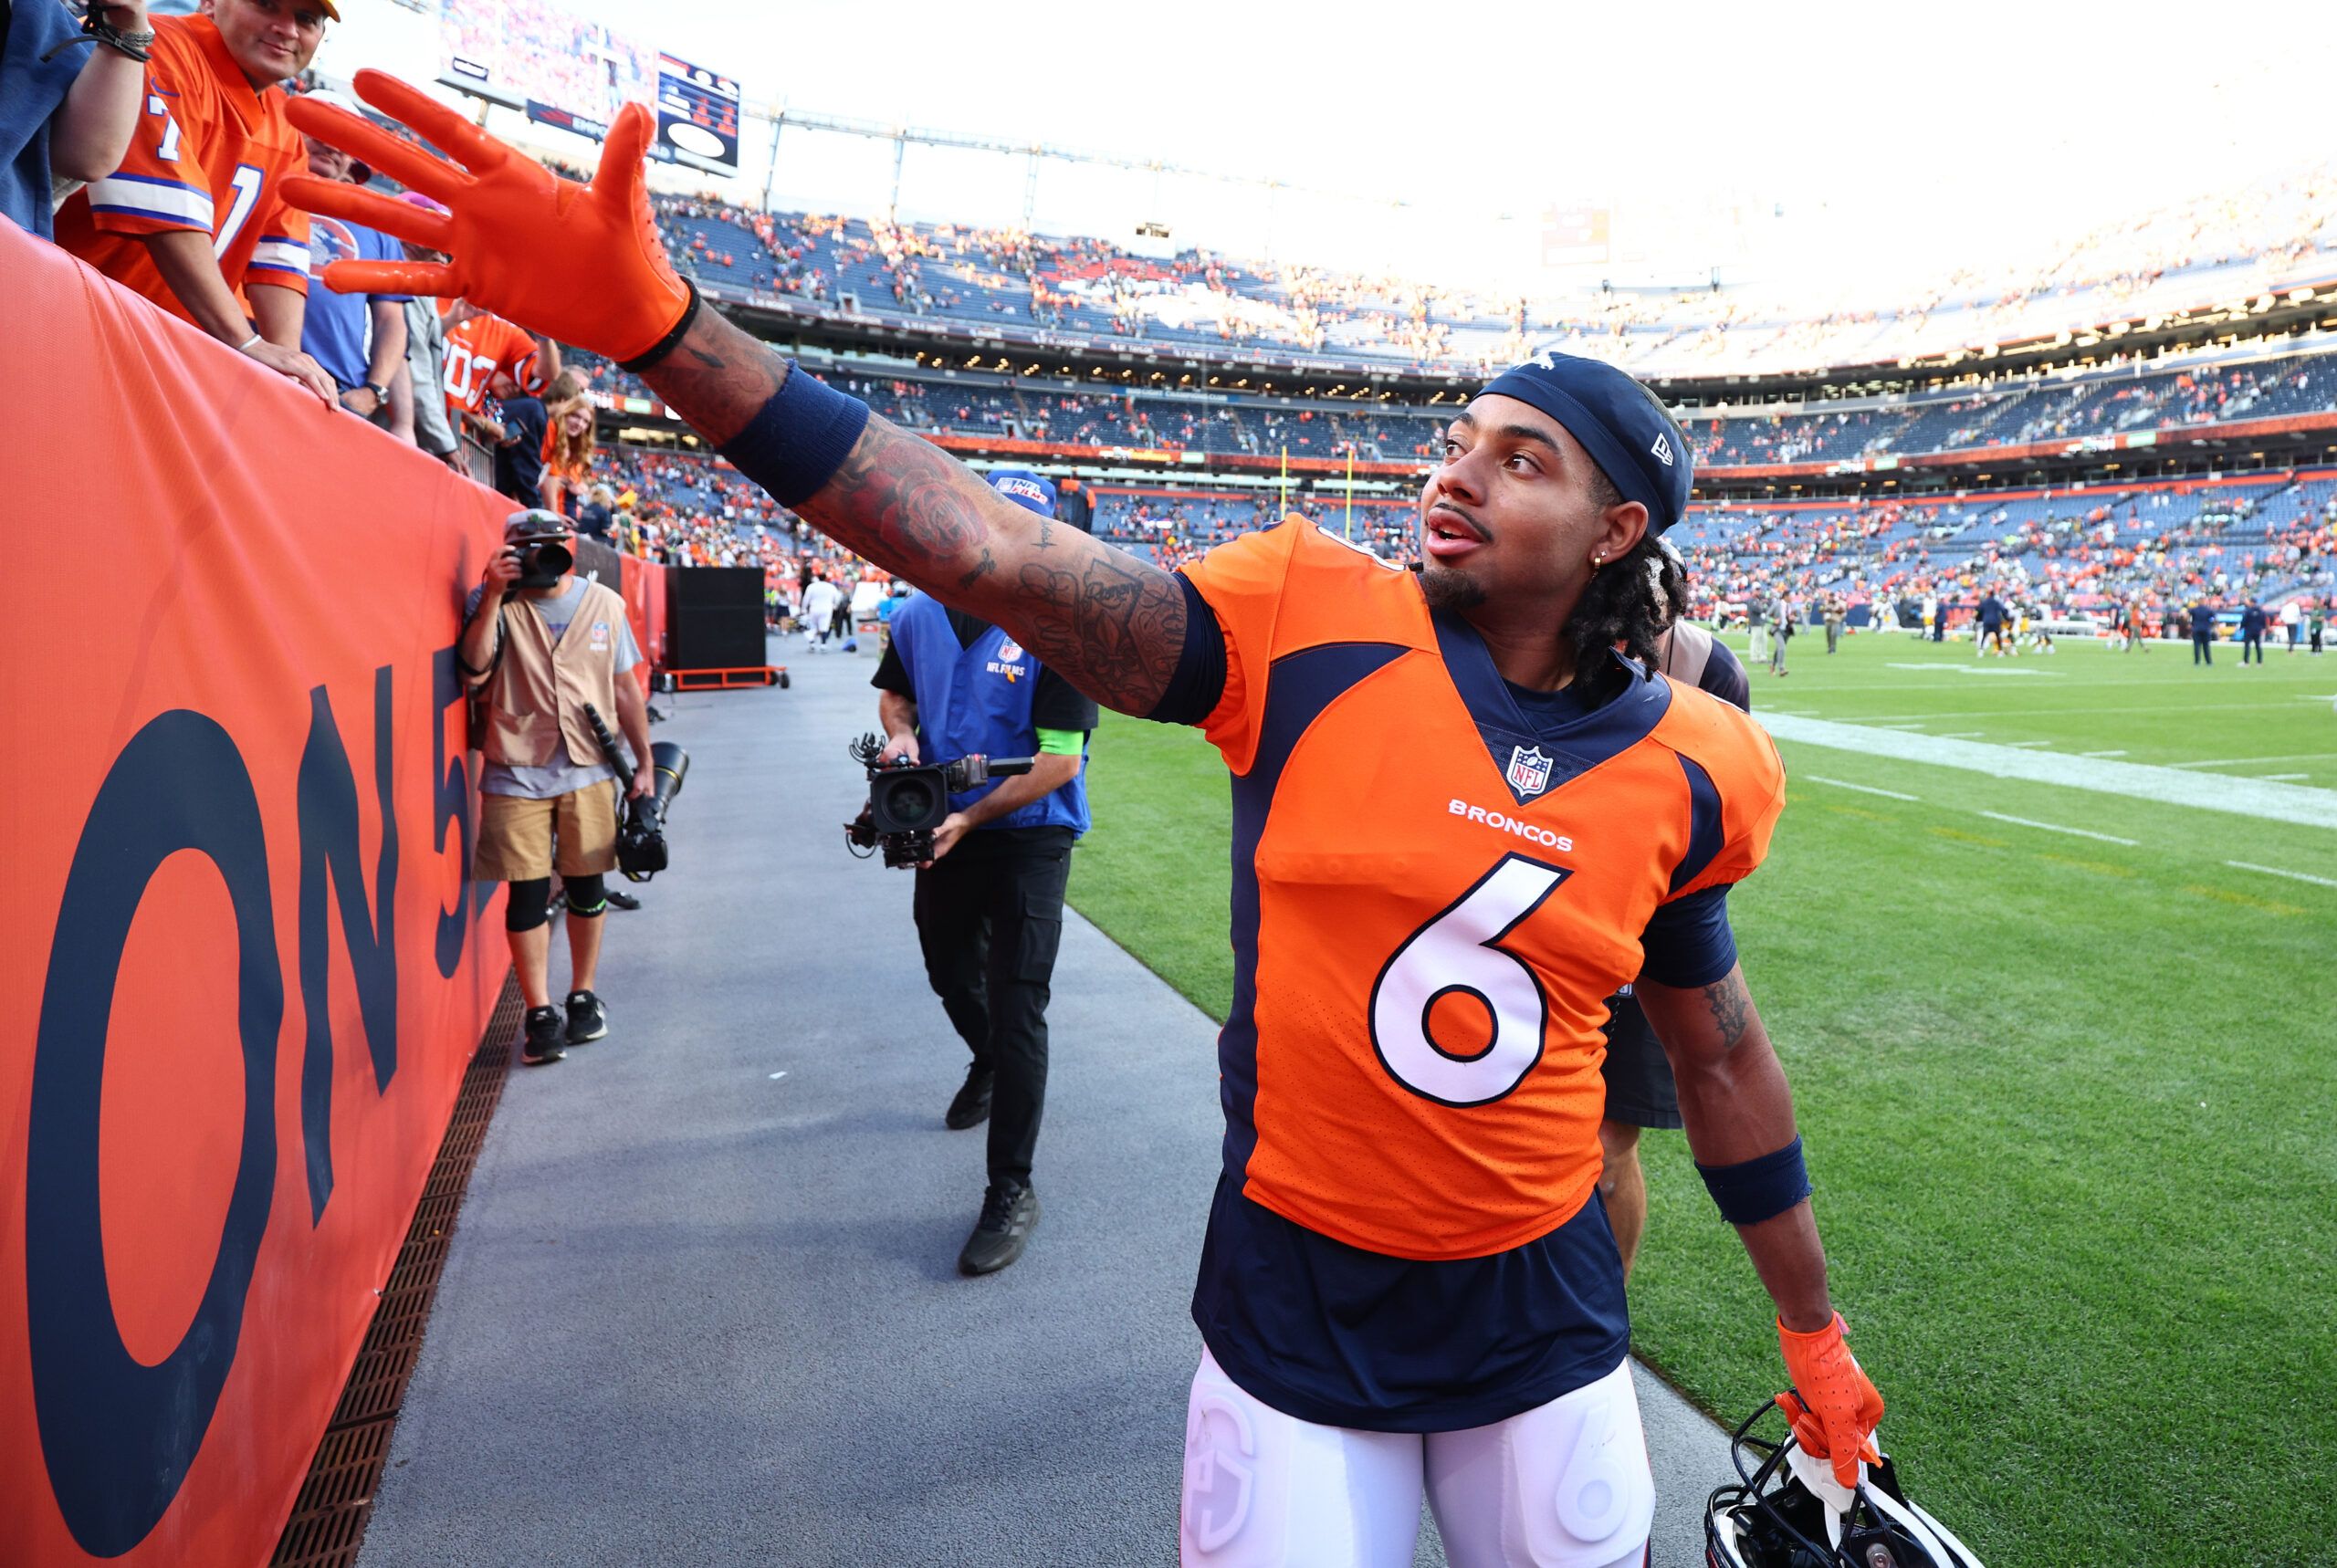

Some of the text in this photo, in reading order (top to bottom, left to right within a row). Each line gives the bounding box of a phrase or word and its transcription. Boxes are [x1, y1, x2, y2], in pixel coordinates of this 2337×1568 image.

[1017, 481, 1041, 492] NFL
[1514, 764, 1540, 788] NFL
[433, 643, 500, 979] 5
[1448, 799, 1573, 852] BRONCOS
[1368, 851, 1575, 1109] 6
